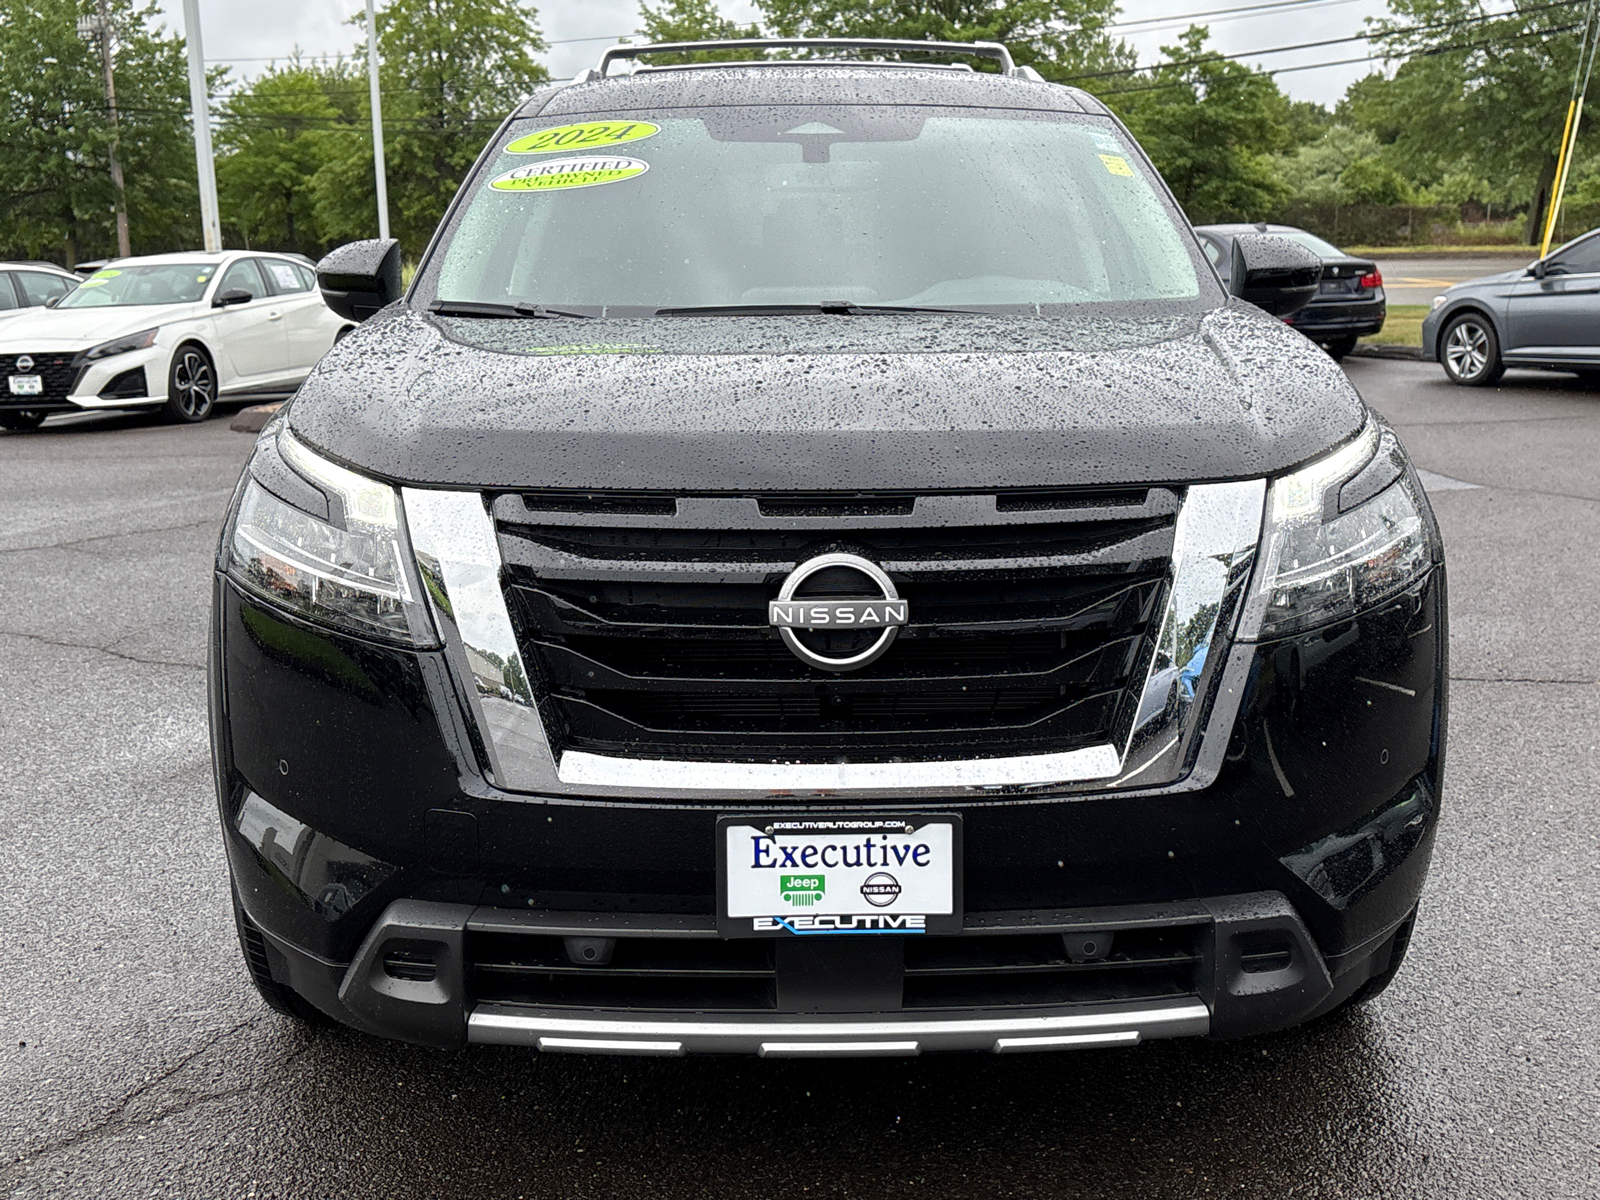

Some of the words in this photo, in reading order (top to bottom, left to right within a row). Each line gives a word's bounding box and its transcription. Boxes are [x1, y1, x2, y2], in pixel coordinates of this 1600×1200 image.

[526, 124, 637, 150] 2024
[510, 160, 632, 179] CERTIFIED
[526, 176, 601, 187] VEHICLE
[773, 605, 905, 624] NISSAN
[773, 821, 906, 829] EXECUTIVEAUTOGROUP.COM
[750, 835, 931, 869] Executive
[786, 877, 819, 891] Jeep
[862, 885, 899, 894] NISSAN
[753, 915, 926, 931] EXECUTIVE
